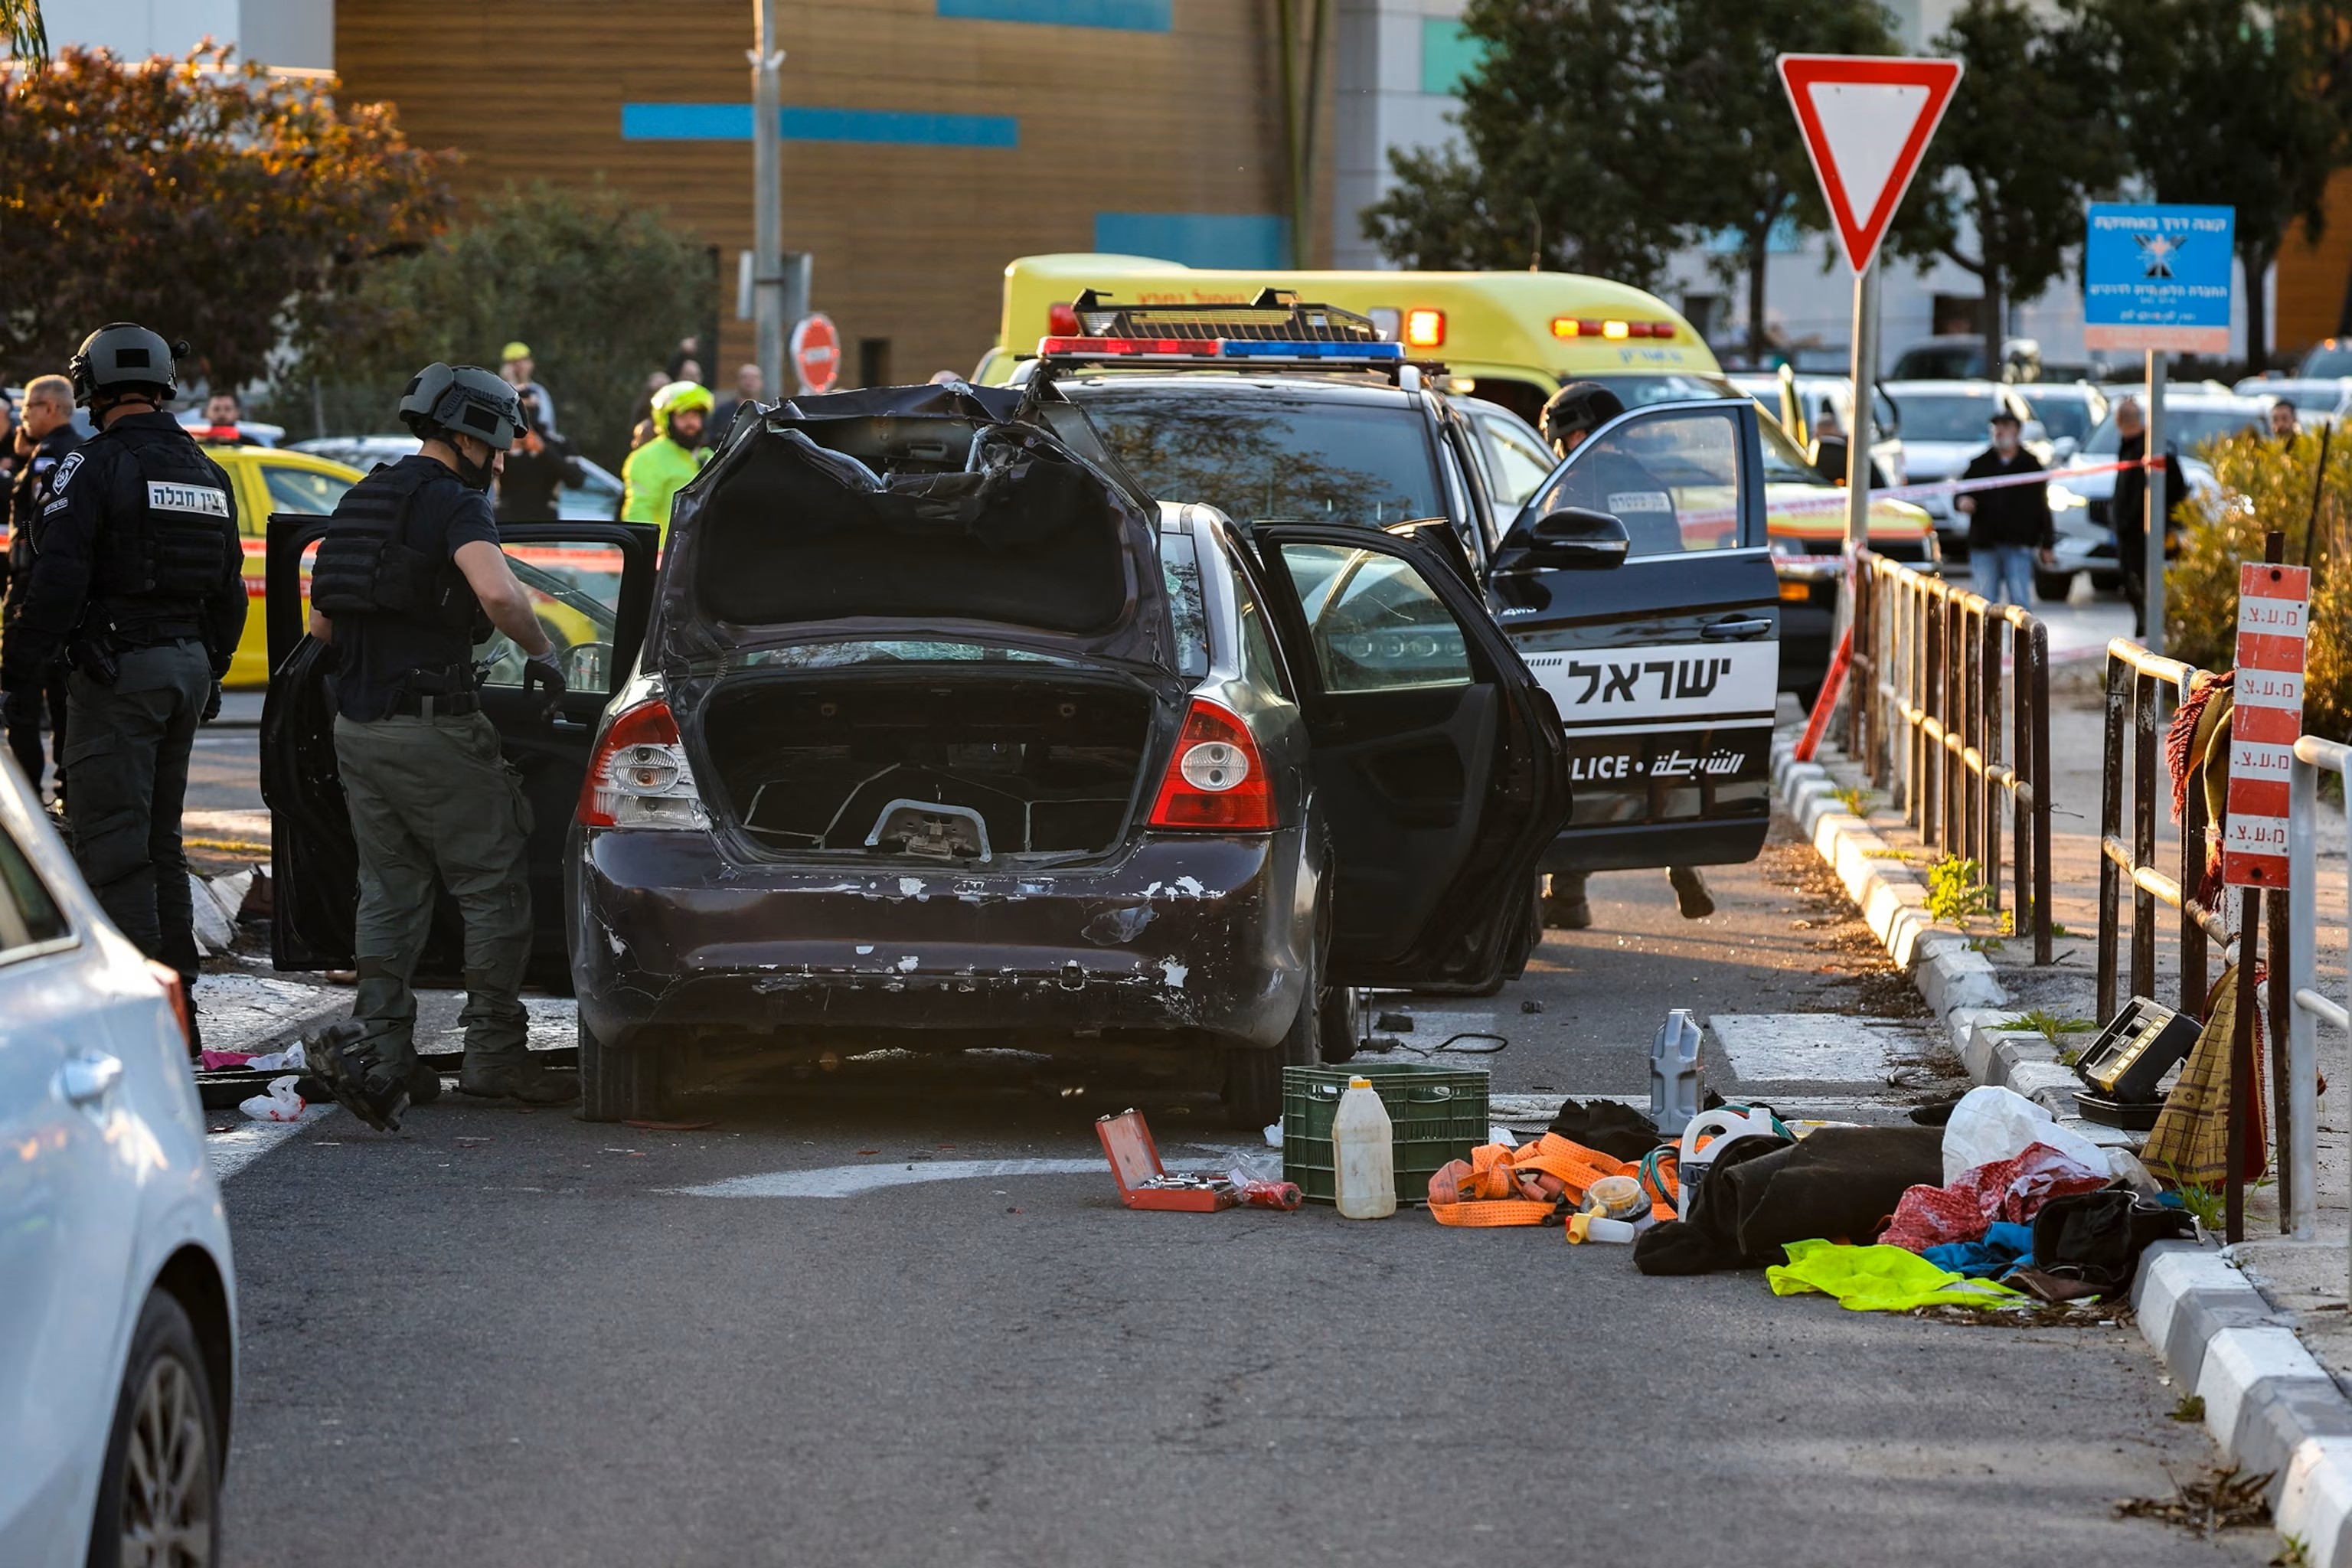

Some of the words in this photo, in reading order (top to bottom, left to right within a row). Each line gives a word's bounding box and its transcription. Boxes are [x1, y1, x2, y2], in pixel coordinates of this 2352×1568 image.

[2161, 217, 2190, 232] דרך
[154, 486, 194, 507] חבלה
[1568, 658, 1731, 704] ישראל
[1570, 756, 1630, 780] LICE
[1650, 748, 1746, 781] الشرطة
[2235, 752, 2289, 769] מ.ע.צ.
[2230, 825, 2285, 844] מ.ע.צ.
